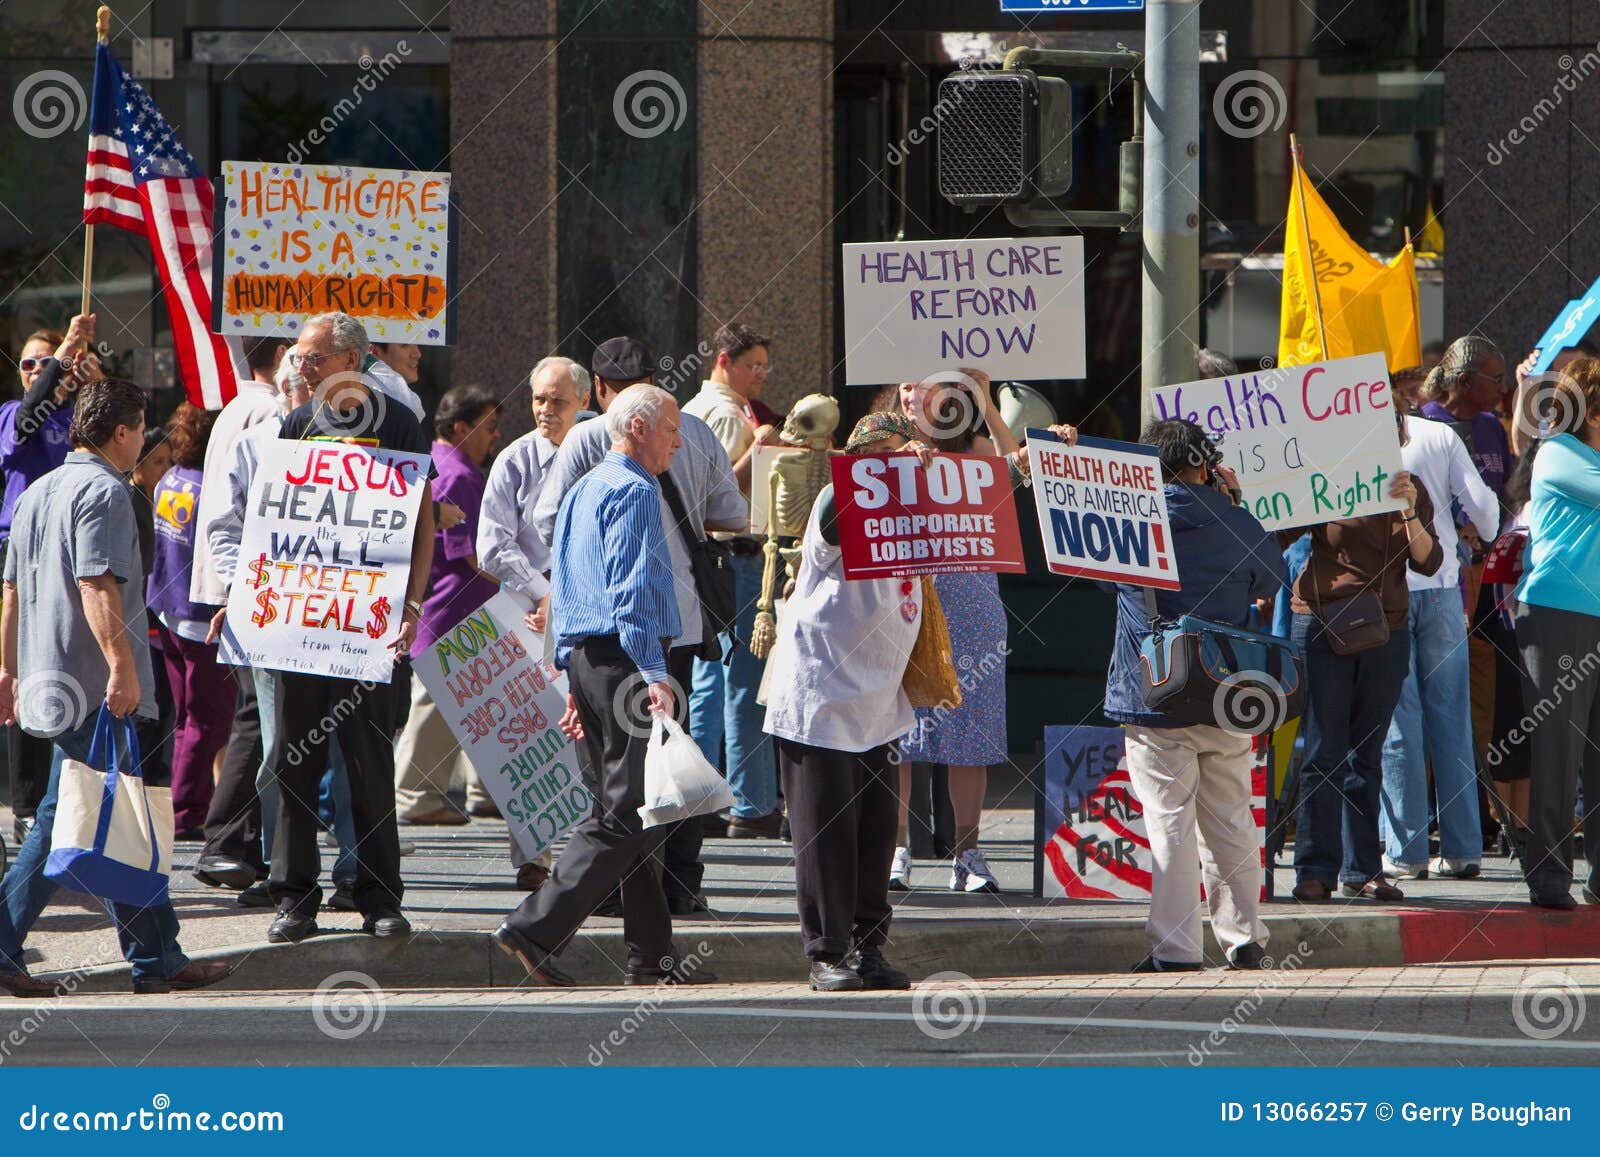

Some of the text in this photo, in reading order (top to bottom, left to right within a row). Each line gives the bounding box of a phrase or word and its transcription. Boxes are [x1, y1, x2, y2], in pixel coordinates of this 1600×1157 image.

[240, 171, 441, 222] HEALTHCARE
[281, 230, 355, 265] IS A
[861, 246, 1062, 283] HEALTH CARE
[233, 276, 313, 310] HUMAN
[911, 285, 1036, 320] REFORM
[941, 324, 1036, 359] NOW
[1302, 367, 1389, 422] Care
[286, 448, 419, 498] JESUS
[1039, 451, 1157, 491] HEALTH CARE
[1238, 437, 1304, 473] is a
[851, 457, 995, 510] STOP
[1044, 480, 1162, 519] FOR AMERICA
[1311, 465, 1389, 517] Right
[317, 526, 340, 542] the
[864, 513, 996, 538] CORPORATE
[1049, 508, 1169, 570] NOW!
[271, 532, 384, 567] WALL
[870, 536, 995, 563] LOBBYISTS
[246, 552, 387, 596] $TREET
[251, 587, 392, 639] $TEAL$
[302, 636, 367, 656] from them
[437, 608, 499, 676] NOW
[446, 630, 527, 708] REFORM
[459, 658, 562, 745] EALTH CARE
[496, 702, 548, 753] PASS
[501, 728, 573, 791] UTURE
[1061, 744, 1118, 785] YES
[529, 785, 594, 851] OTECT
[1064, 787, 1143, 827] HEAL
